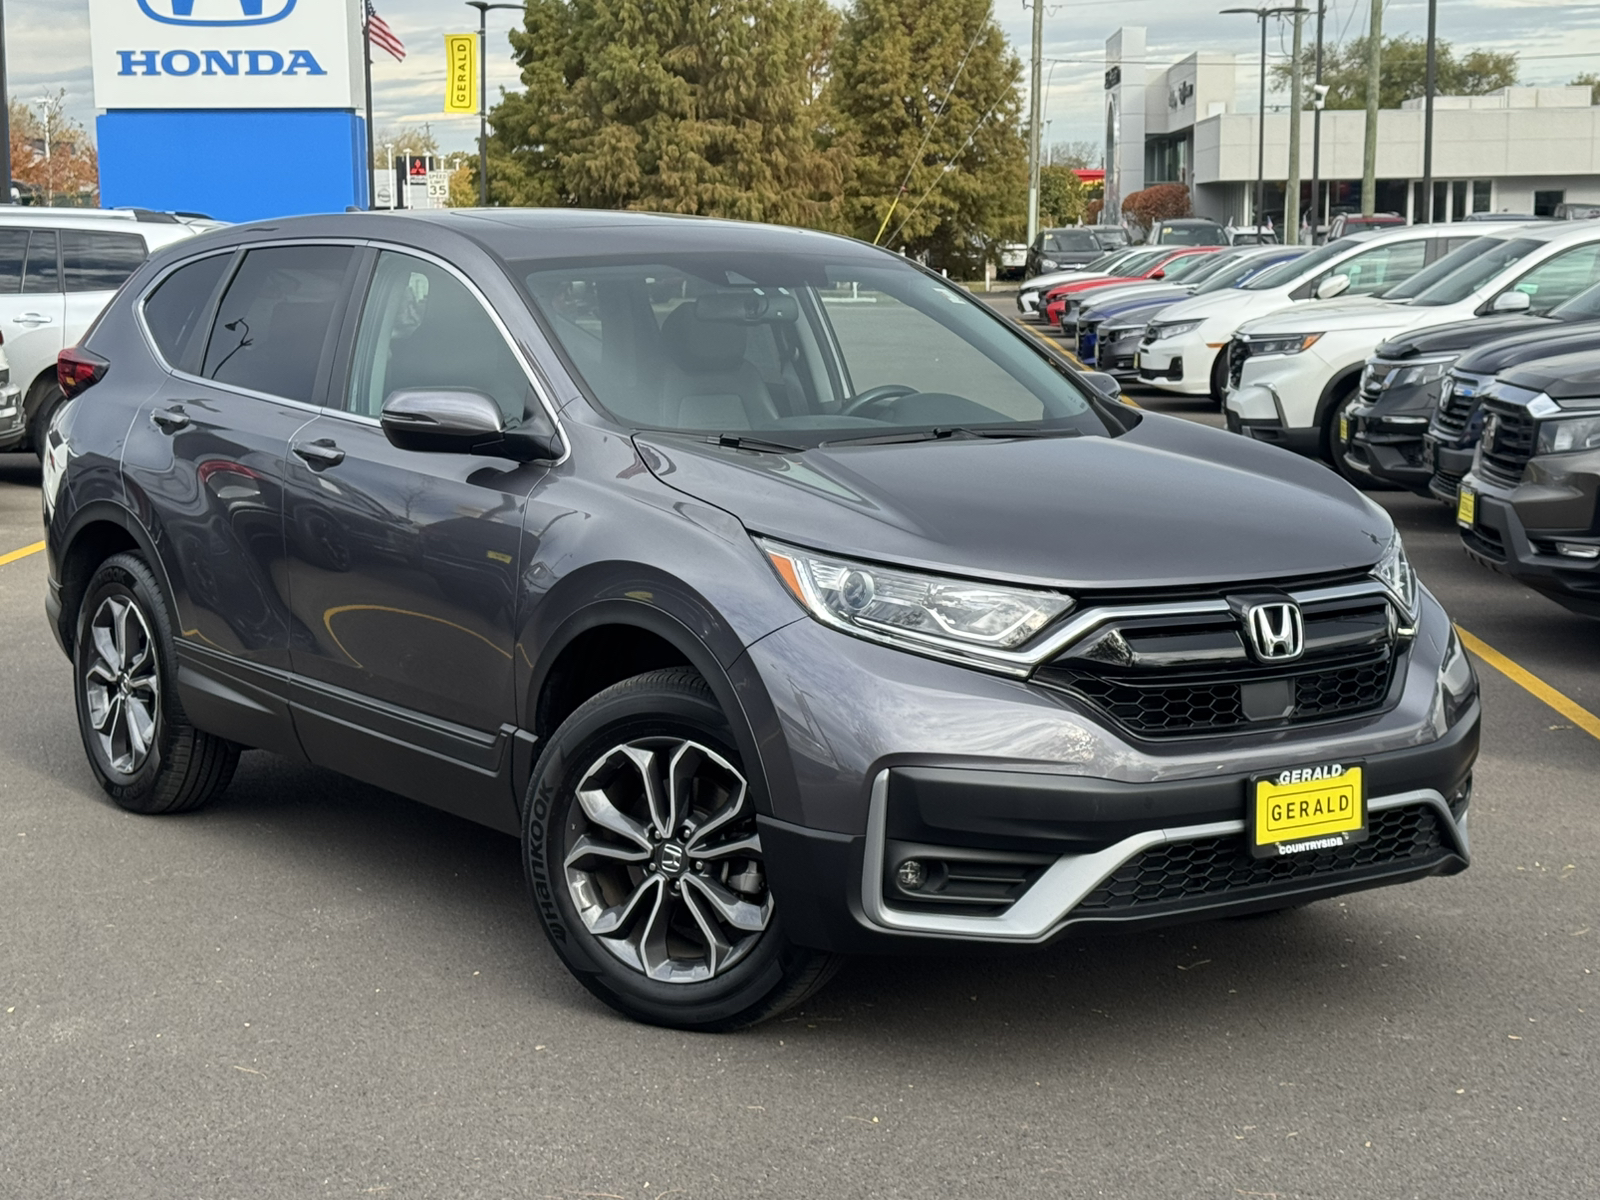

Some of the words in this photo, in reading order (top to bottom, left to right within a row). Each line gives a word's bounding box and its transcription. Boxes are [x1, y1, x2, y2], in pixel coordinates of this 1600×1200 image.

[116, 49, 328, 77] HONDA
[456, 43, 467, 103] GERALD
[429, 185, 447, 196] 35
[1279, 763, 1342, 785] GERALD
[1271, 794, 1349, 822] GERALD
[1279, 836, 1344, 855] COUNTRYSIDE
